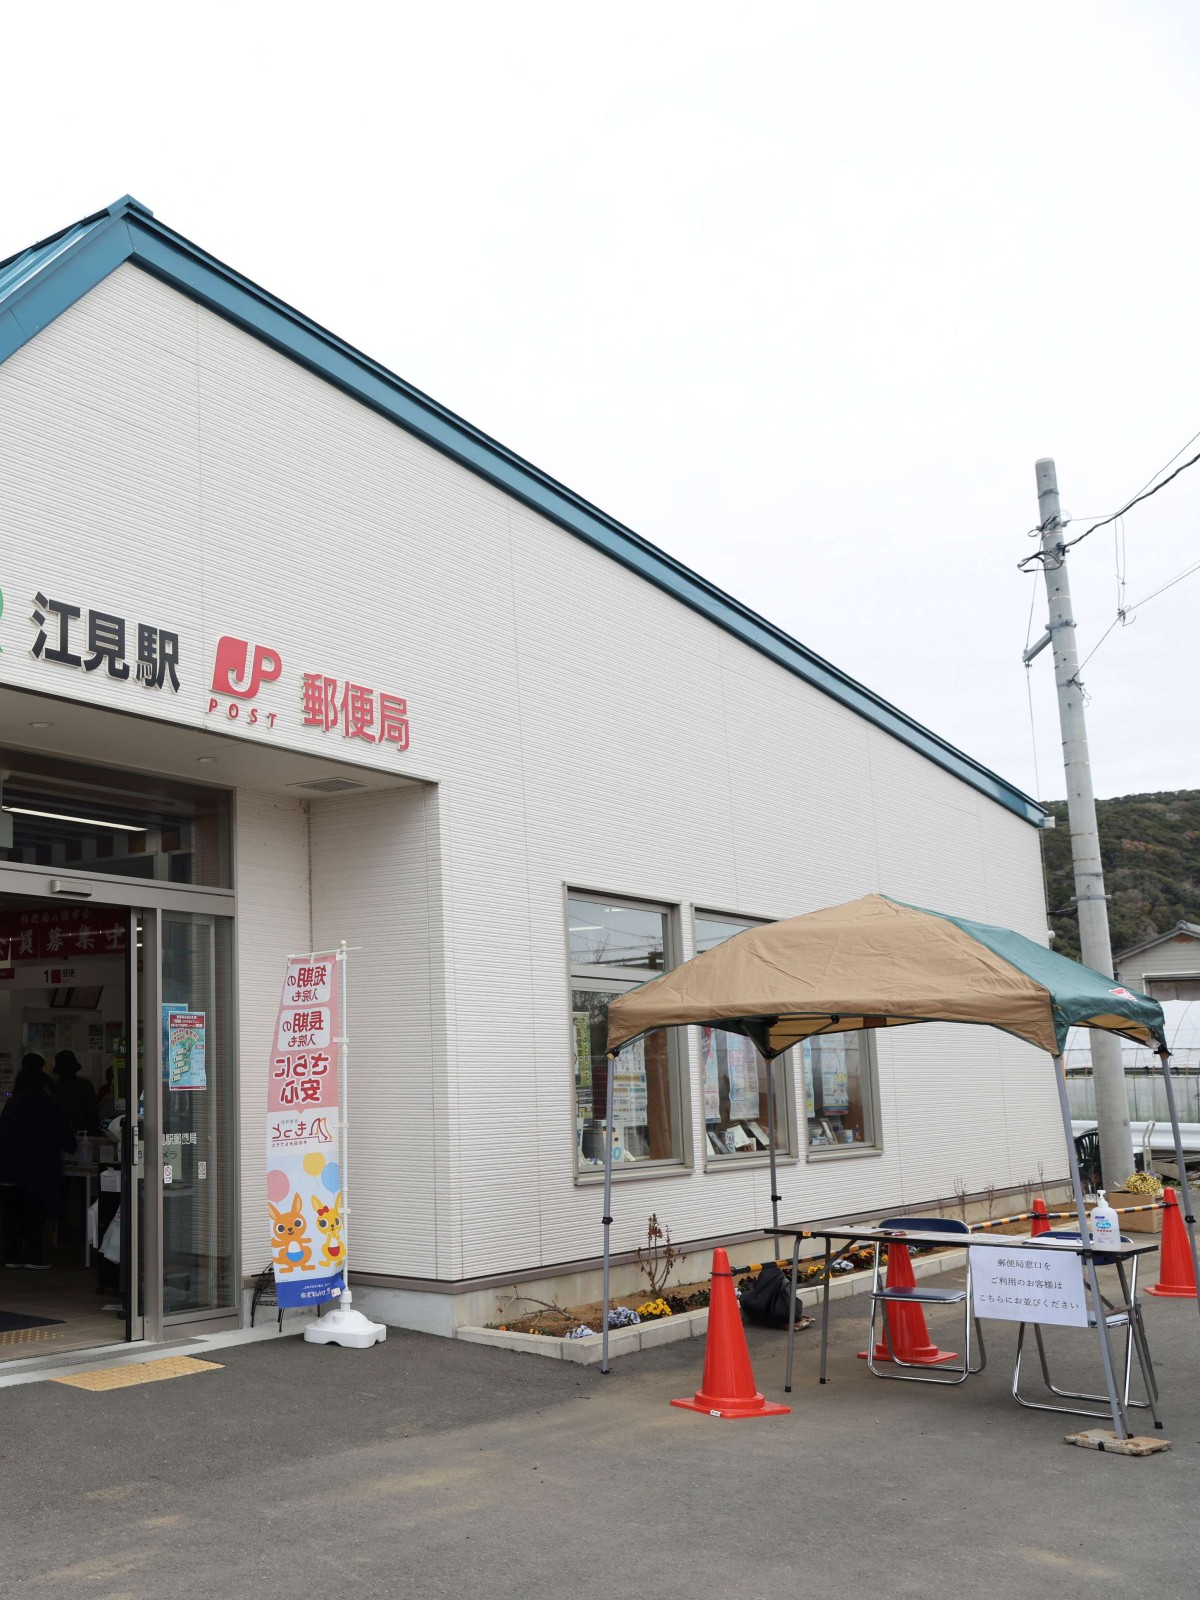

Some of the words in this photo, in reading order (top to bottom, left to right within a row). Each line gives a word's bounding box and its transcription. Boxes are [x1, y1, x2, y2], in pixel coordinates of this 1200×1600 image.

[30, 591, 181, 694] 江見駅
[212, 635, 282, 700] JP
[301, 672, 411, 752] 郵便局
[208, 698, 278, 729] POST
[997, 1258, 1051, 1270] 郵便局窓口を
[991, 1276, 1063, 1290] ご利用のお客様は
[979, 1294, 1079, 1309] こちらにお並びください
